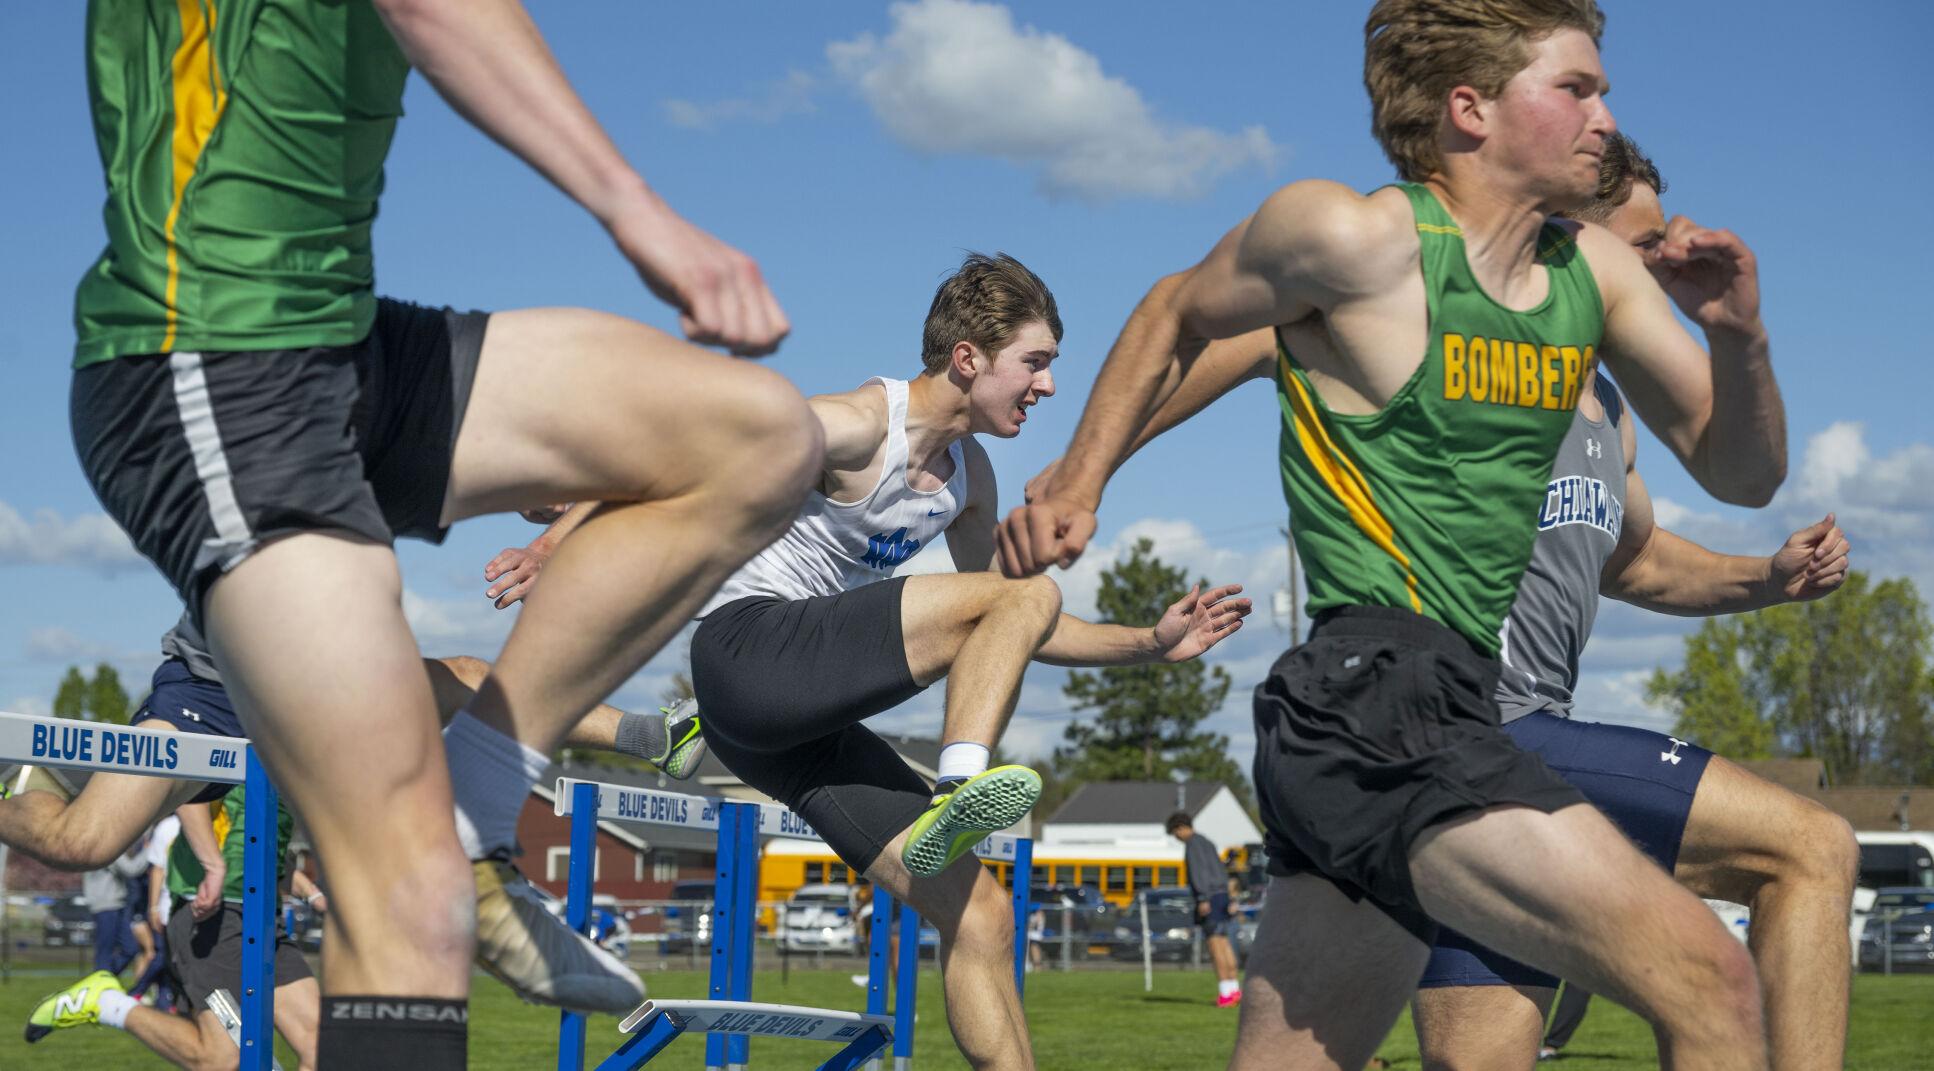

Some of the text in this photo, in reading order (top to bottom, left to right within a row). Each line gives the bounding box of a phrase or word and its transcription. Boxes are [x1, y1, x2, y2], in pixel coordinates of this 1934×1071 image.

[32, 723, 179, 770] BLUE DEVILS
[209, 748, 237, 769] GILL
[618, 791, 647, 819] BLUE
[650, 796, 688, 823] DEVILS
[781, 811, 808, 835] BLUE
[331, 1001, 468, 1023] ZENSA
[707, 1012, 759, 1033] BLUE
[753, 1014, 824, 1037] DEVILS
